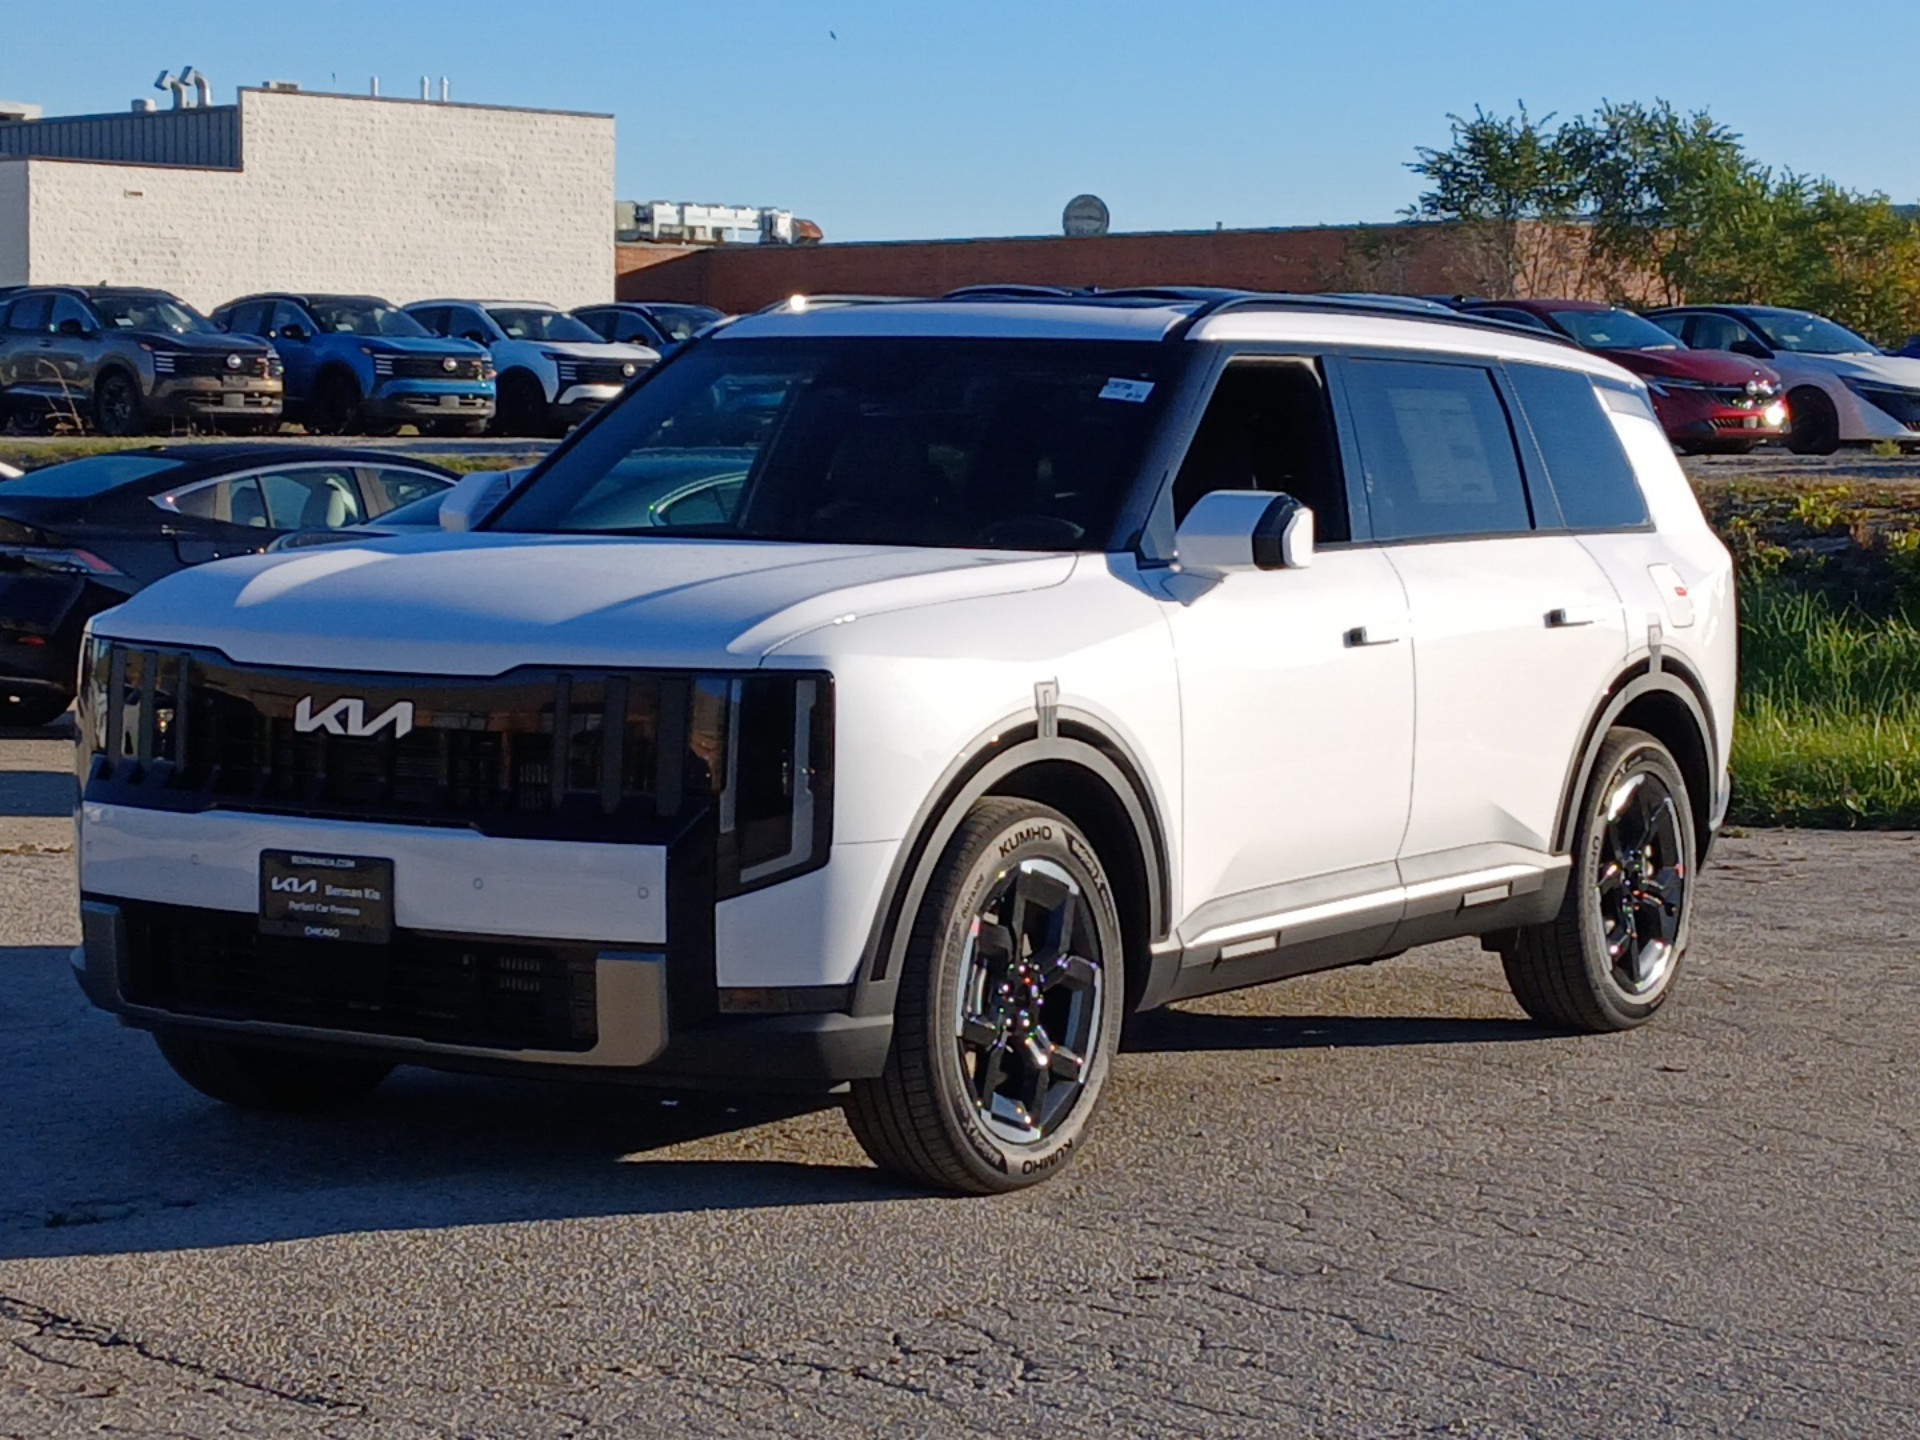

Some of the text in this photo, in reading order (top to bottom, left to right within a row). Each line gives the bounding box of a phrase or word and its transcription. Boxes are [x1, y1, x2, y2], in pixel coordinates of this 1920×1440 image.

[295, 696, 413, 738] KIA
[998, 825, 1053, 858] KUMHO
[271, 876, 317, 893] KIA
[304, 926, 340, 938] CHICAGO
